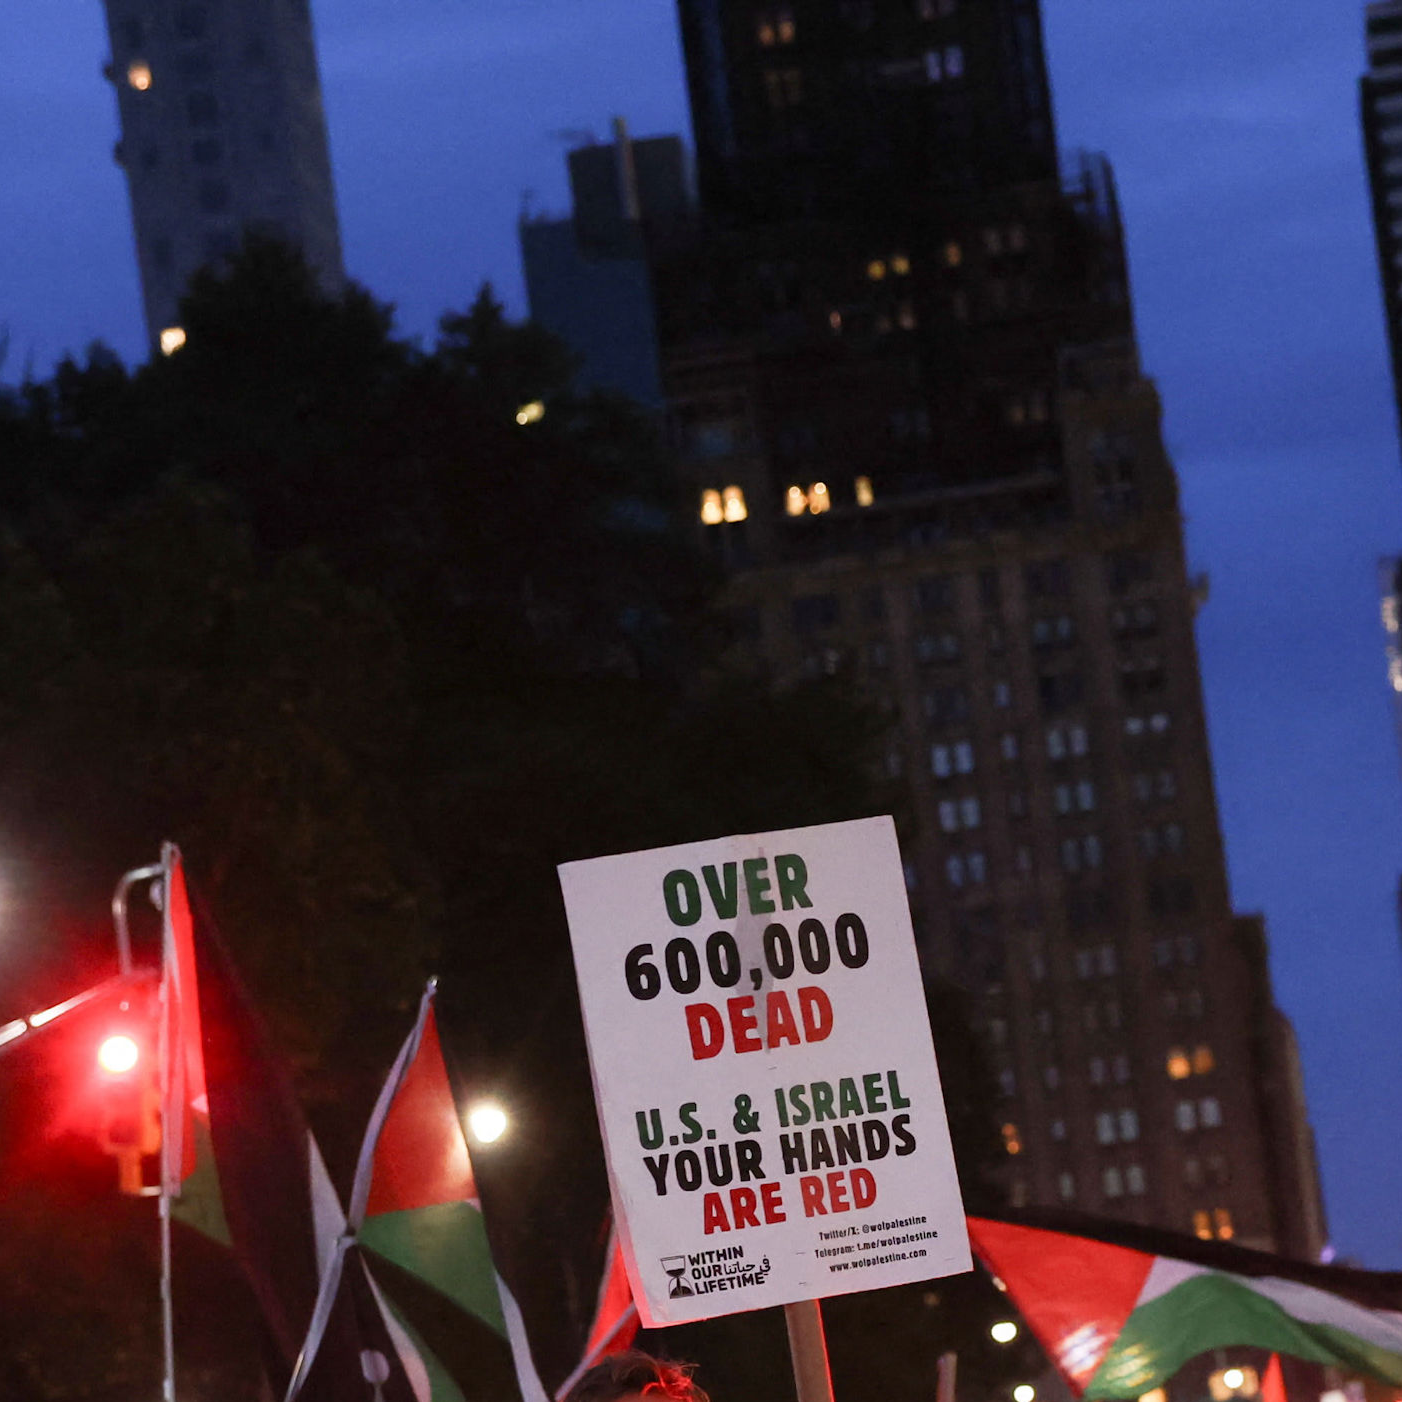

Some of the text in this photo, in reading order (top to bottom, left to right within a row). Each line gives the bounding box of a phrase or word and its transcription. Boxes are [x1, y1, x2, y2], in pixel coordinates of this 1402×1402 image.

[663, 854, 813, 926] OVER
[625, 913, 869, 1000] 600,000
[685, 986, 833, 1060] DEAD
[636, 1071, 910, 1149] U.S. & ISRAEL
[643, 1114, 917, 1195] YOUR HANDS
[704, 1168, 877, 1234] ARE RED
[688, 1245, 744, 1266] WITHIN
[692, 1263, 722, 1280] OUR
[695, 1272, 765, 1295] LIFETIME
[814, 1246, 855, 1258] Telegram:
